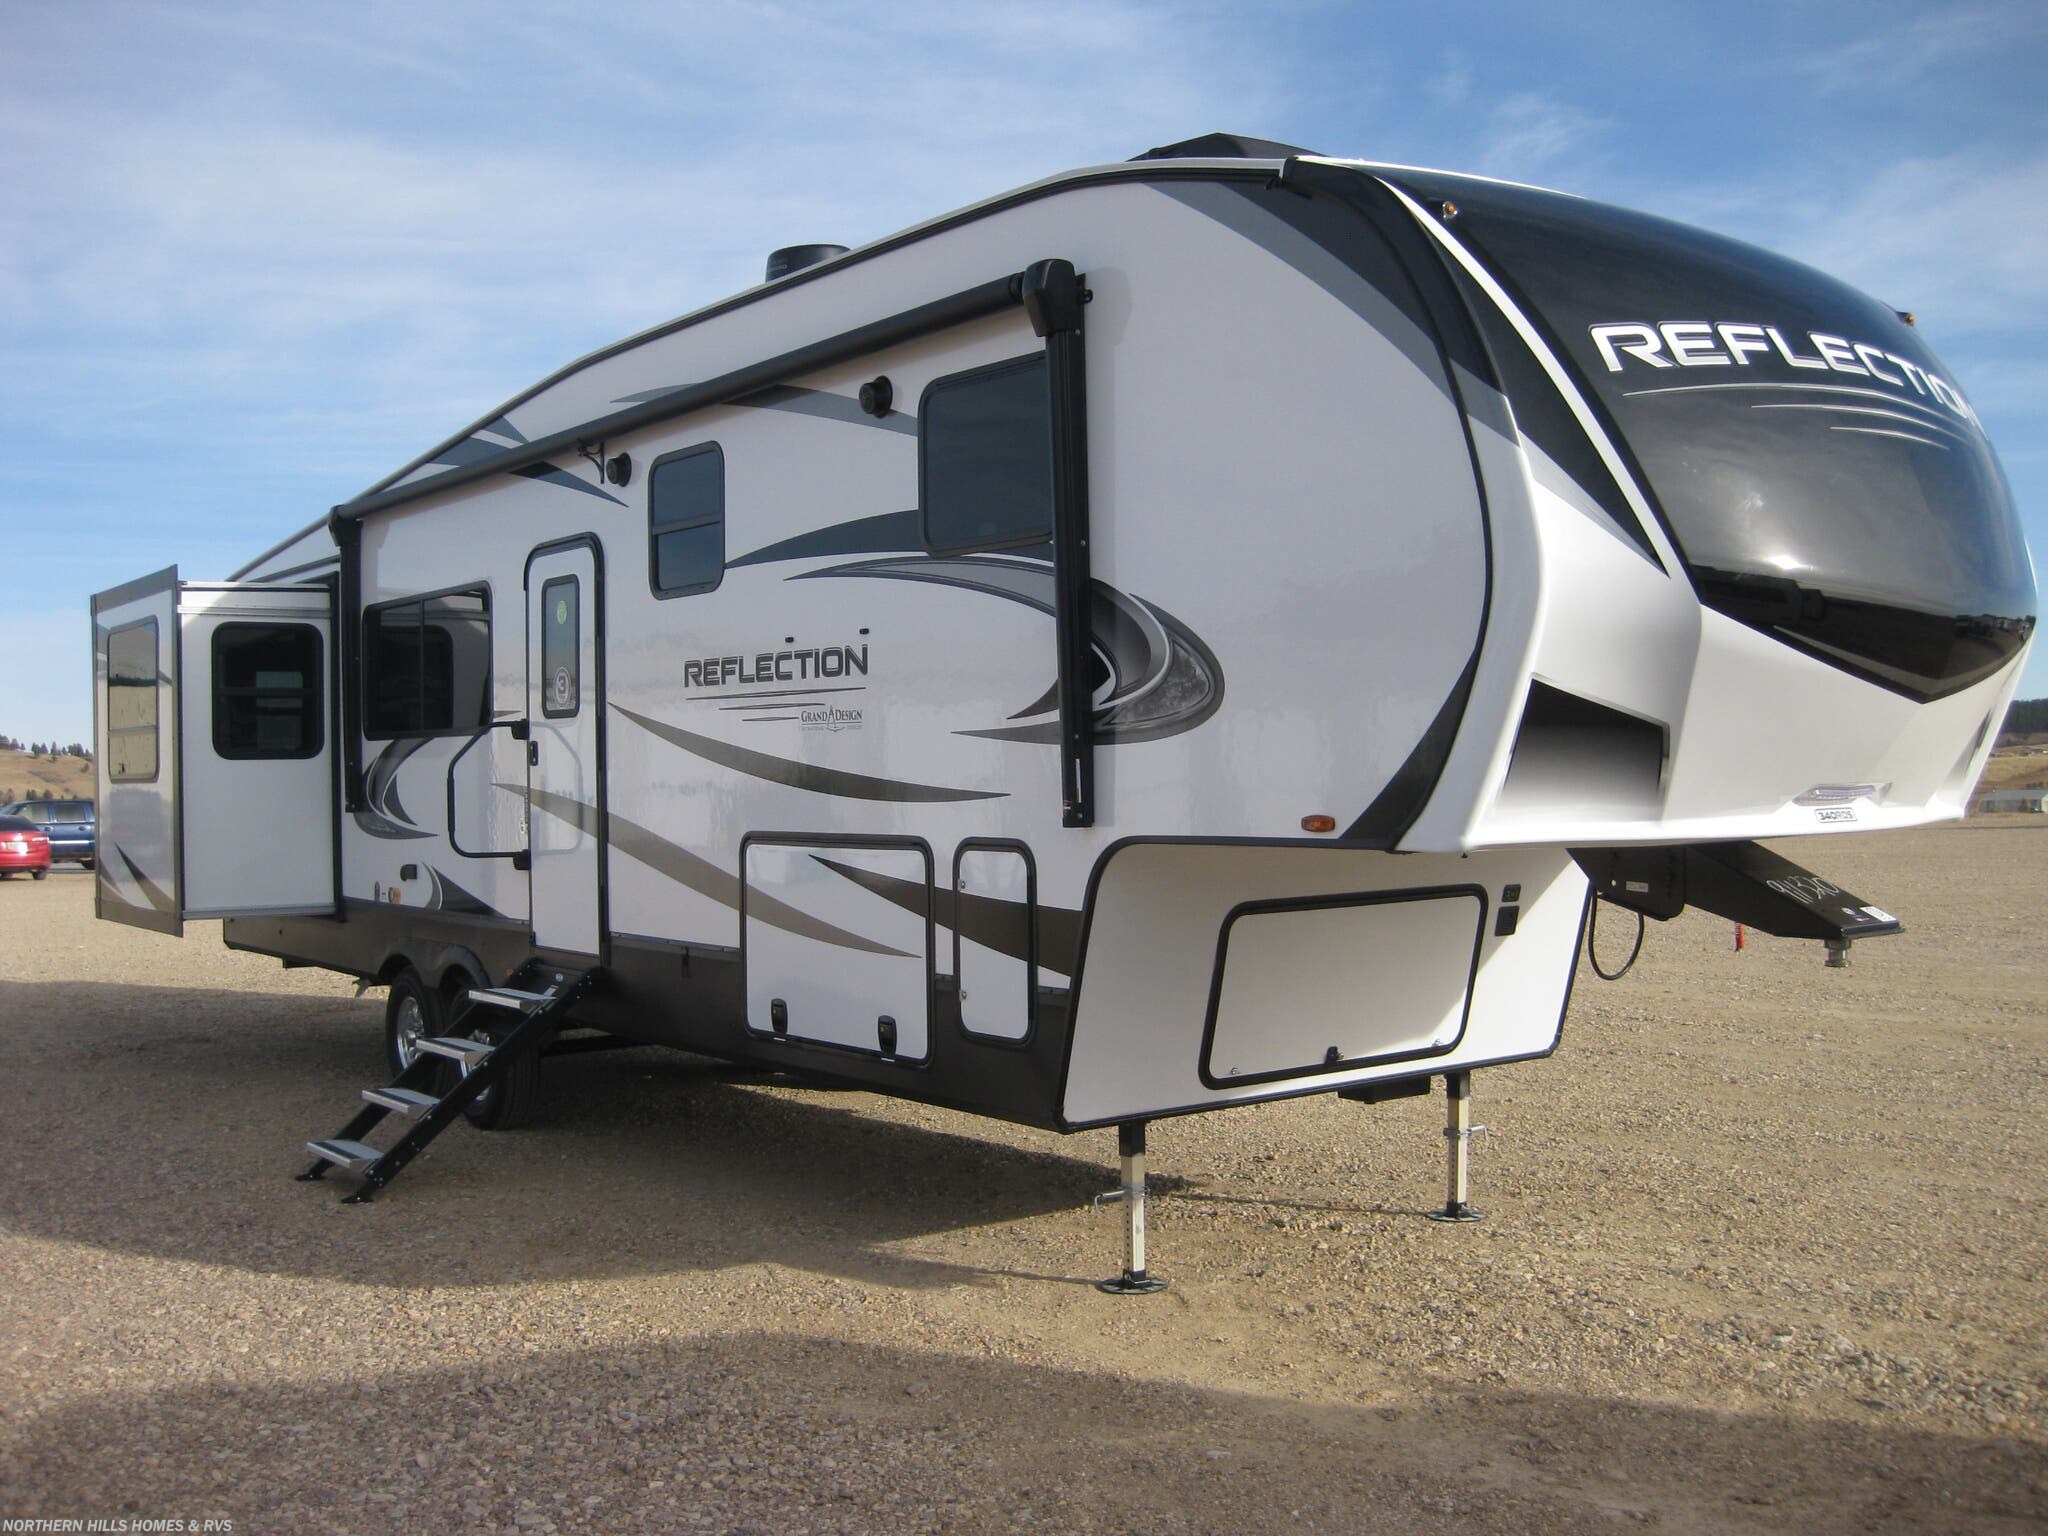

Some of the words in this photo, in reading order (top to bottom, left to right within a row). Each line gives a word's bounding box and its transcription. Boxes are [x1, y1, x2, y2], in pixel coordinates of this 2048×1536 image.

[684, 644, 868, 688] REFLECTION
[801, 710, 828, 722] GRAND
[835, 709, 863, 720] DESIGN
